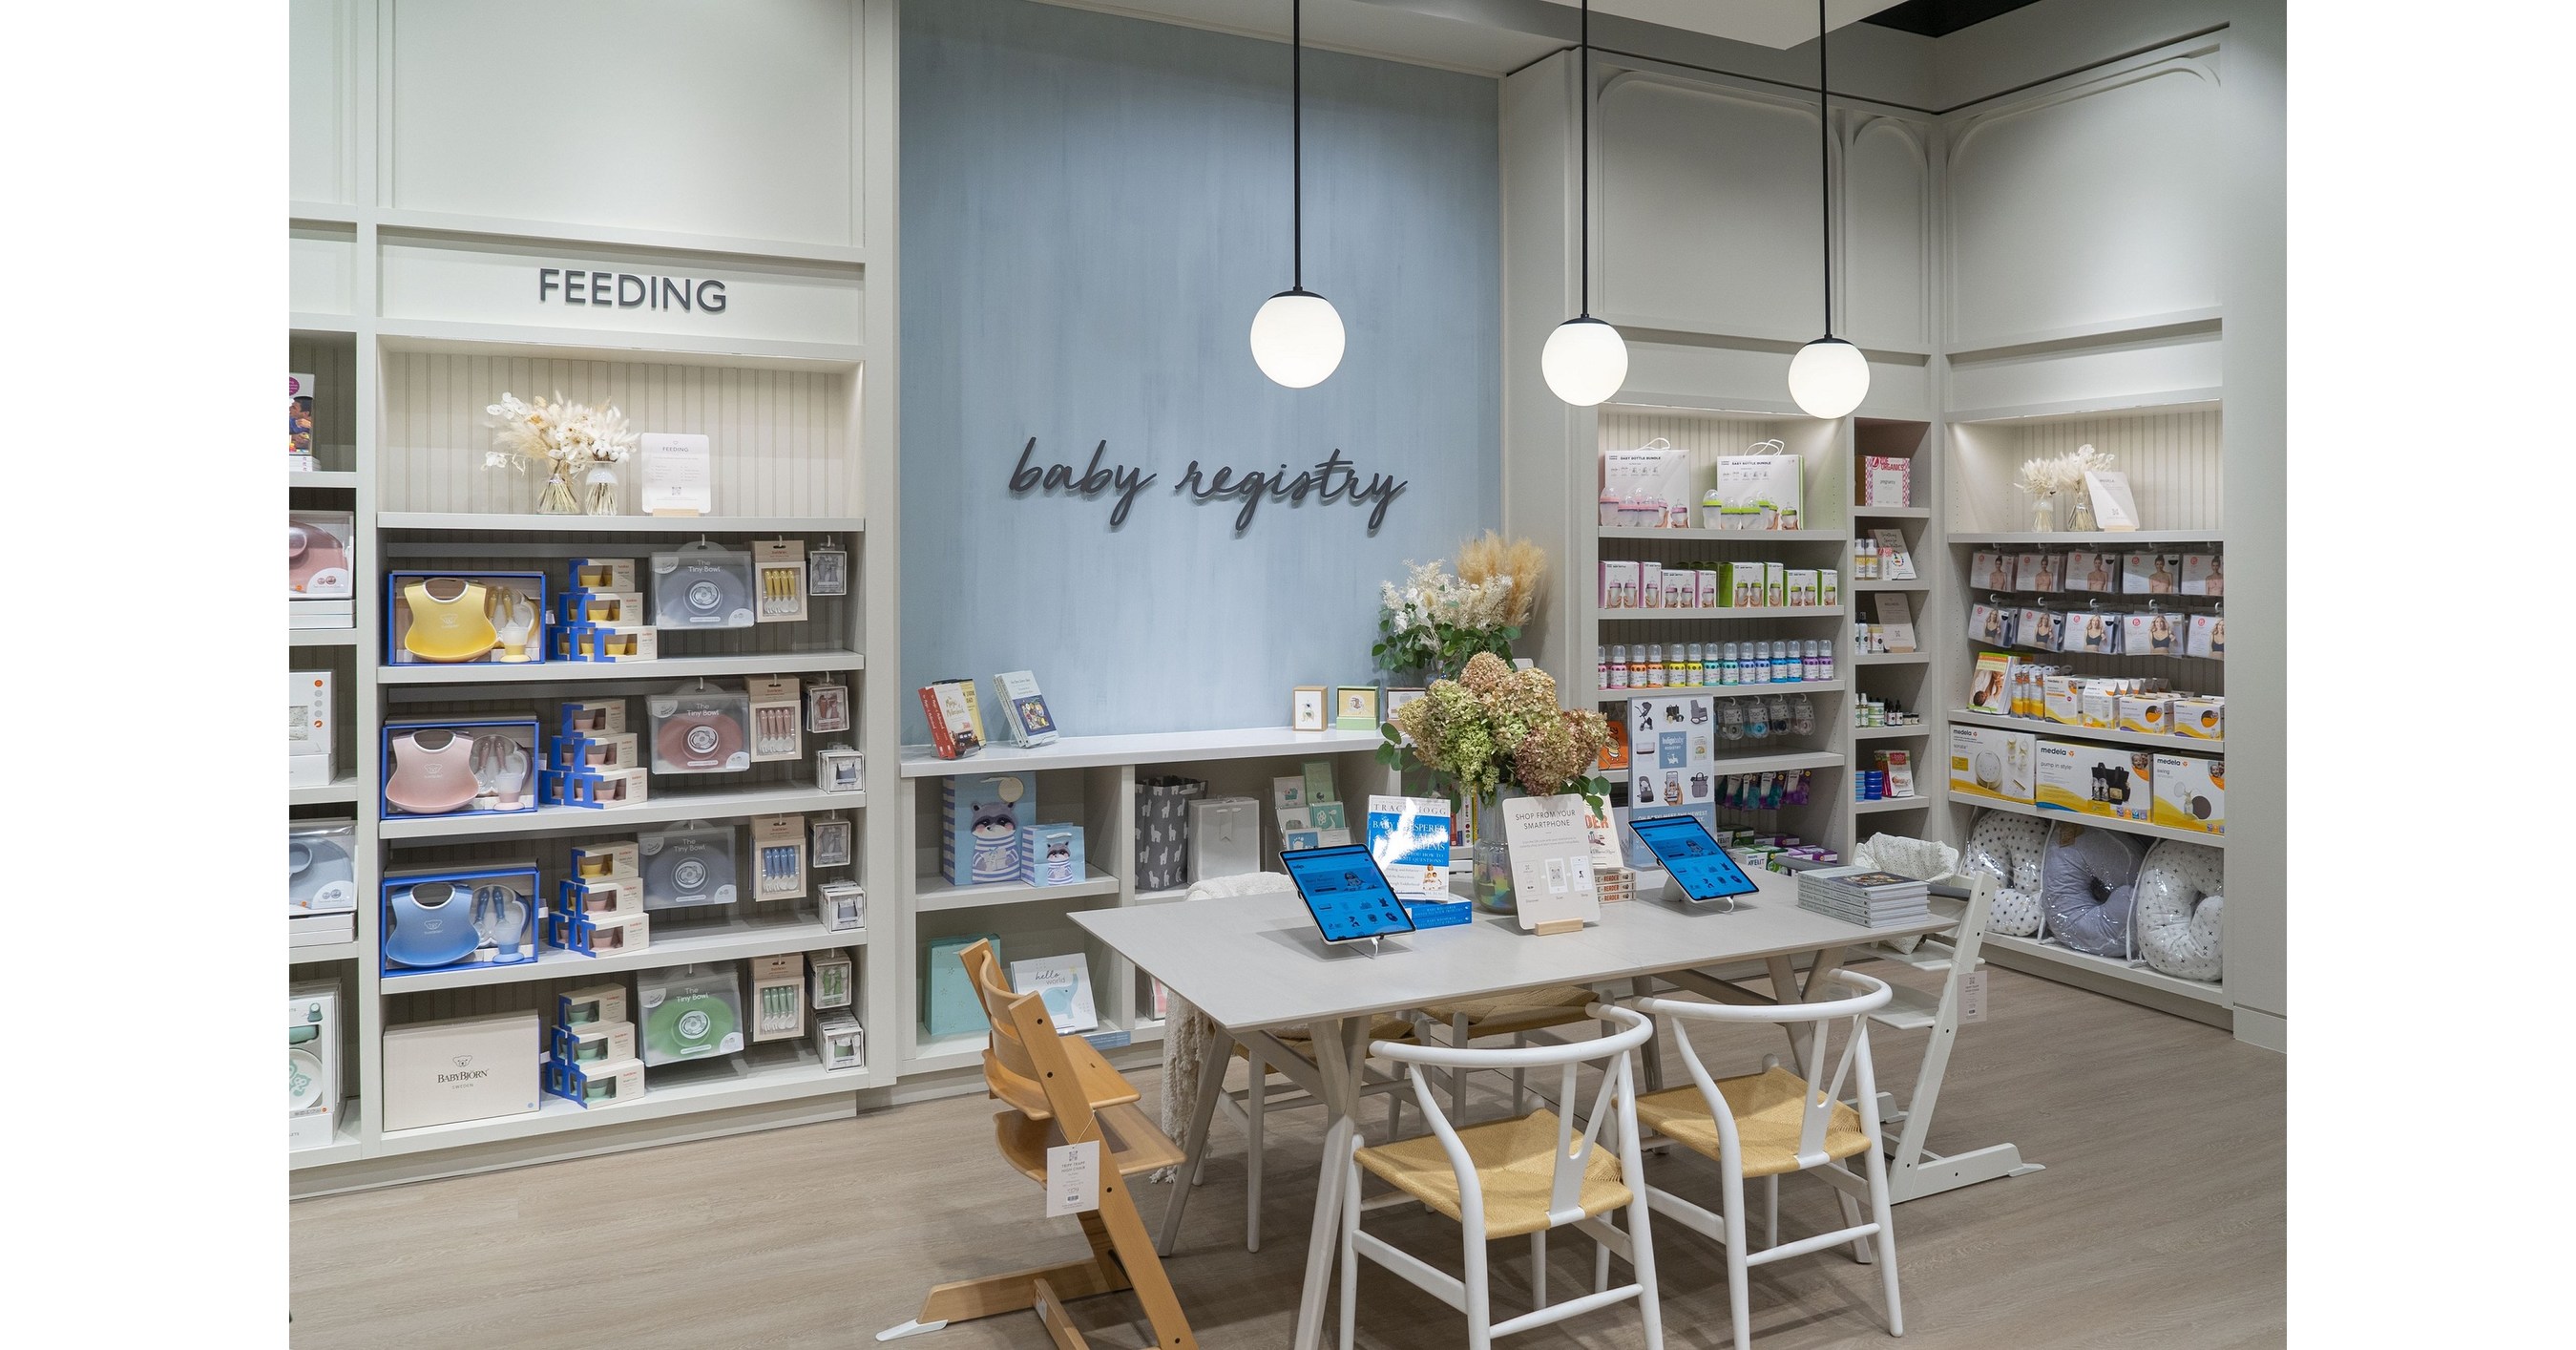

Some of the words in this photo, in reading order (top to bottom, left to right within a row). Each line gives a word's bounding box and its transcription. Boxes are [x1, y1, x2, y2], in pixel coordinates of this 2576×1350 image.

[540, 268, 726, 312] FEEDING
[1009, 436, 1157, 528] baby
[1175, 448, 1408, 535] registry
[2041, 747, 2067, 756] medela
[1515, 812, 1534, 821] SHOP
[1536, 811, 1557, 819] FROM
[1585, 814, 1609, 829] DER
[1523, 819, 1570, 830] SMARTPHONE
[1035, 969, 1060, 981] hello
[1045, 977, 1066, 985] world
[676, 995, 691, 1003] Tiny
